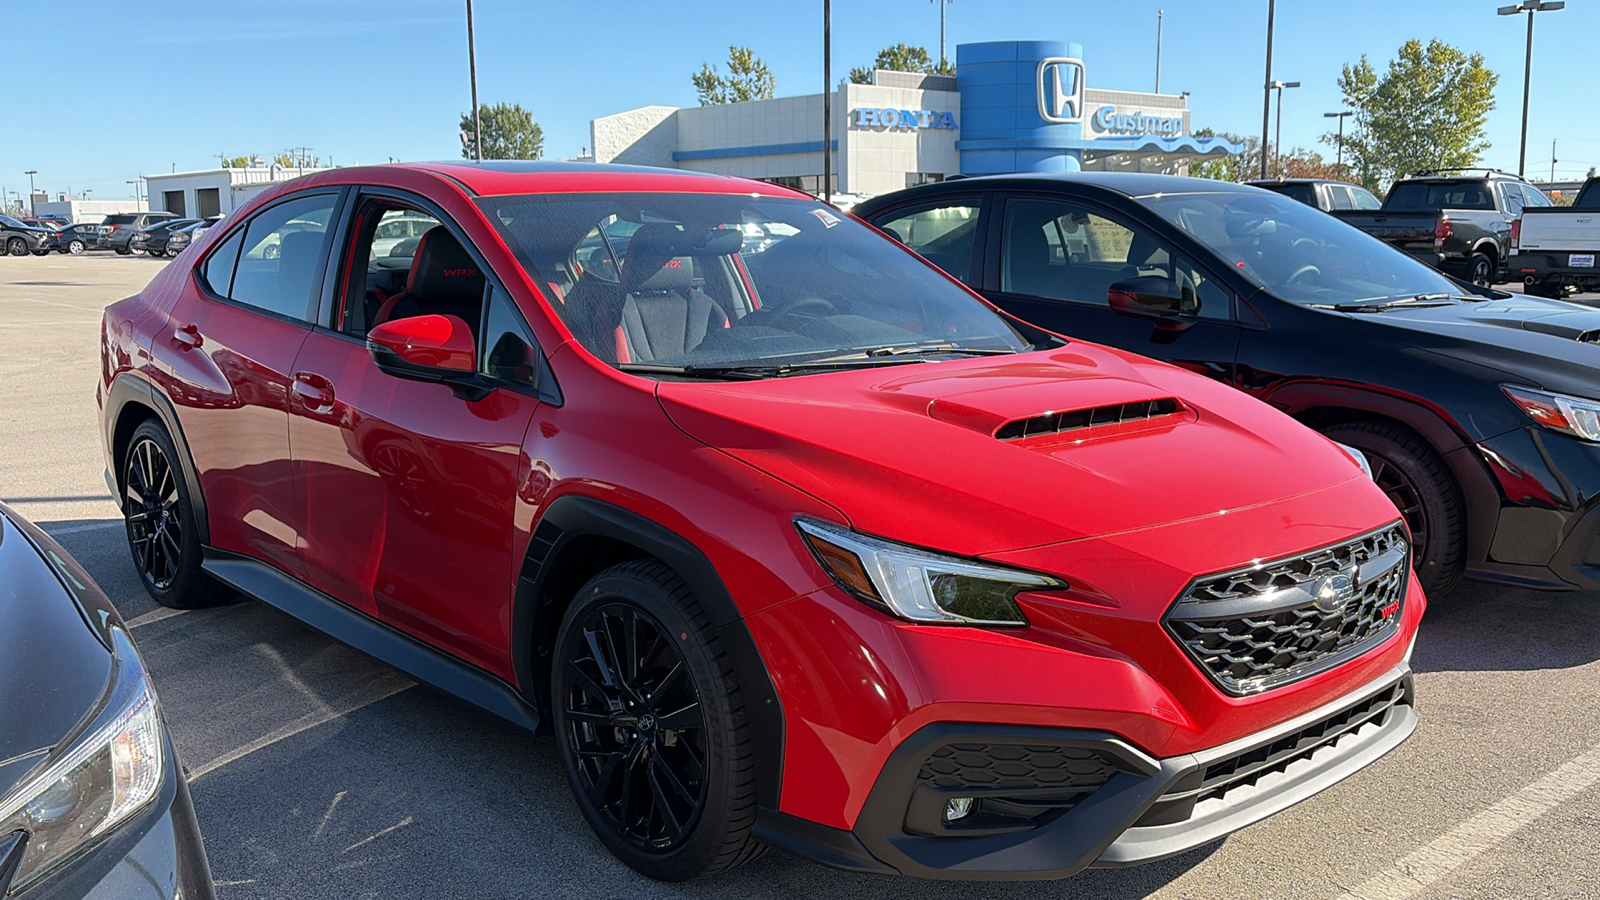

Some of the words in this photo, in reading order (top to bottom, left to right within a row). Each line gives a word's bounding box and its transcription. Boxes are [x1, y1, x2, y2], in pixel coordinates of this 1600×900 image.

[856, 107, 959, 130] HONDA
[1097, 105, 1184, 133] Gustman
[443, 268, 476, 277] WRX
[1381, 599, 1400, 619] WRX
